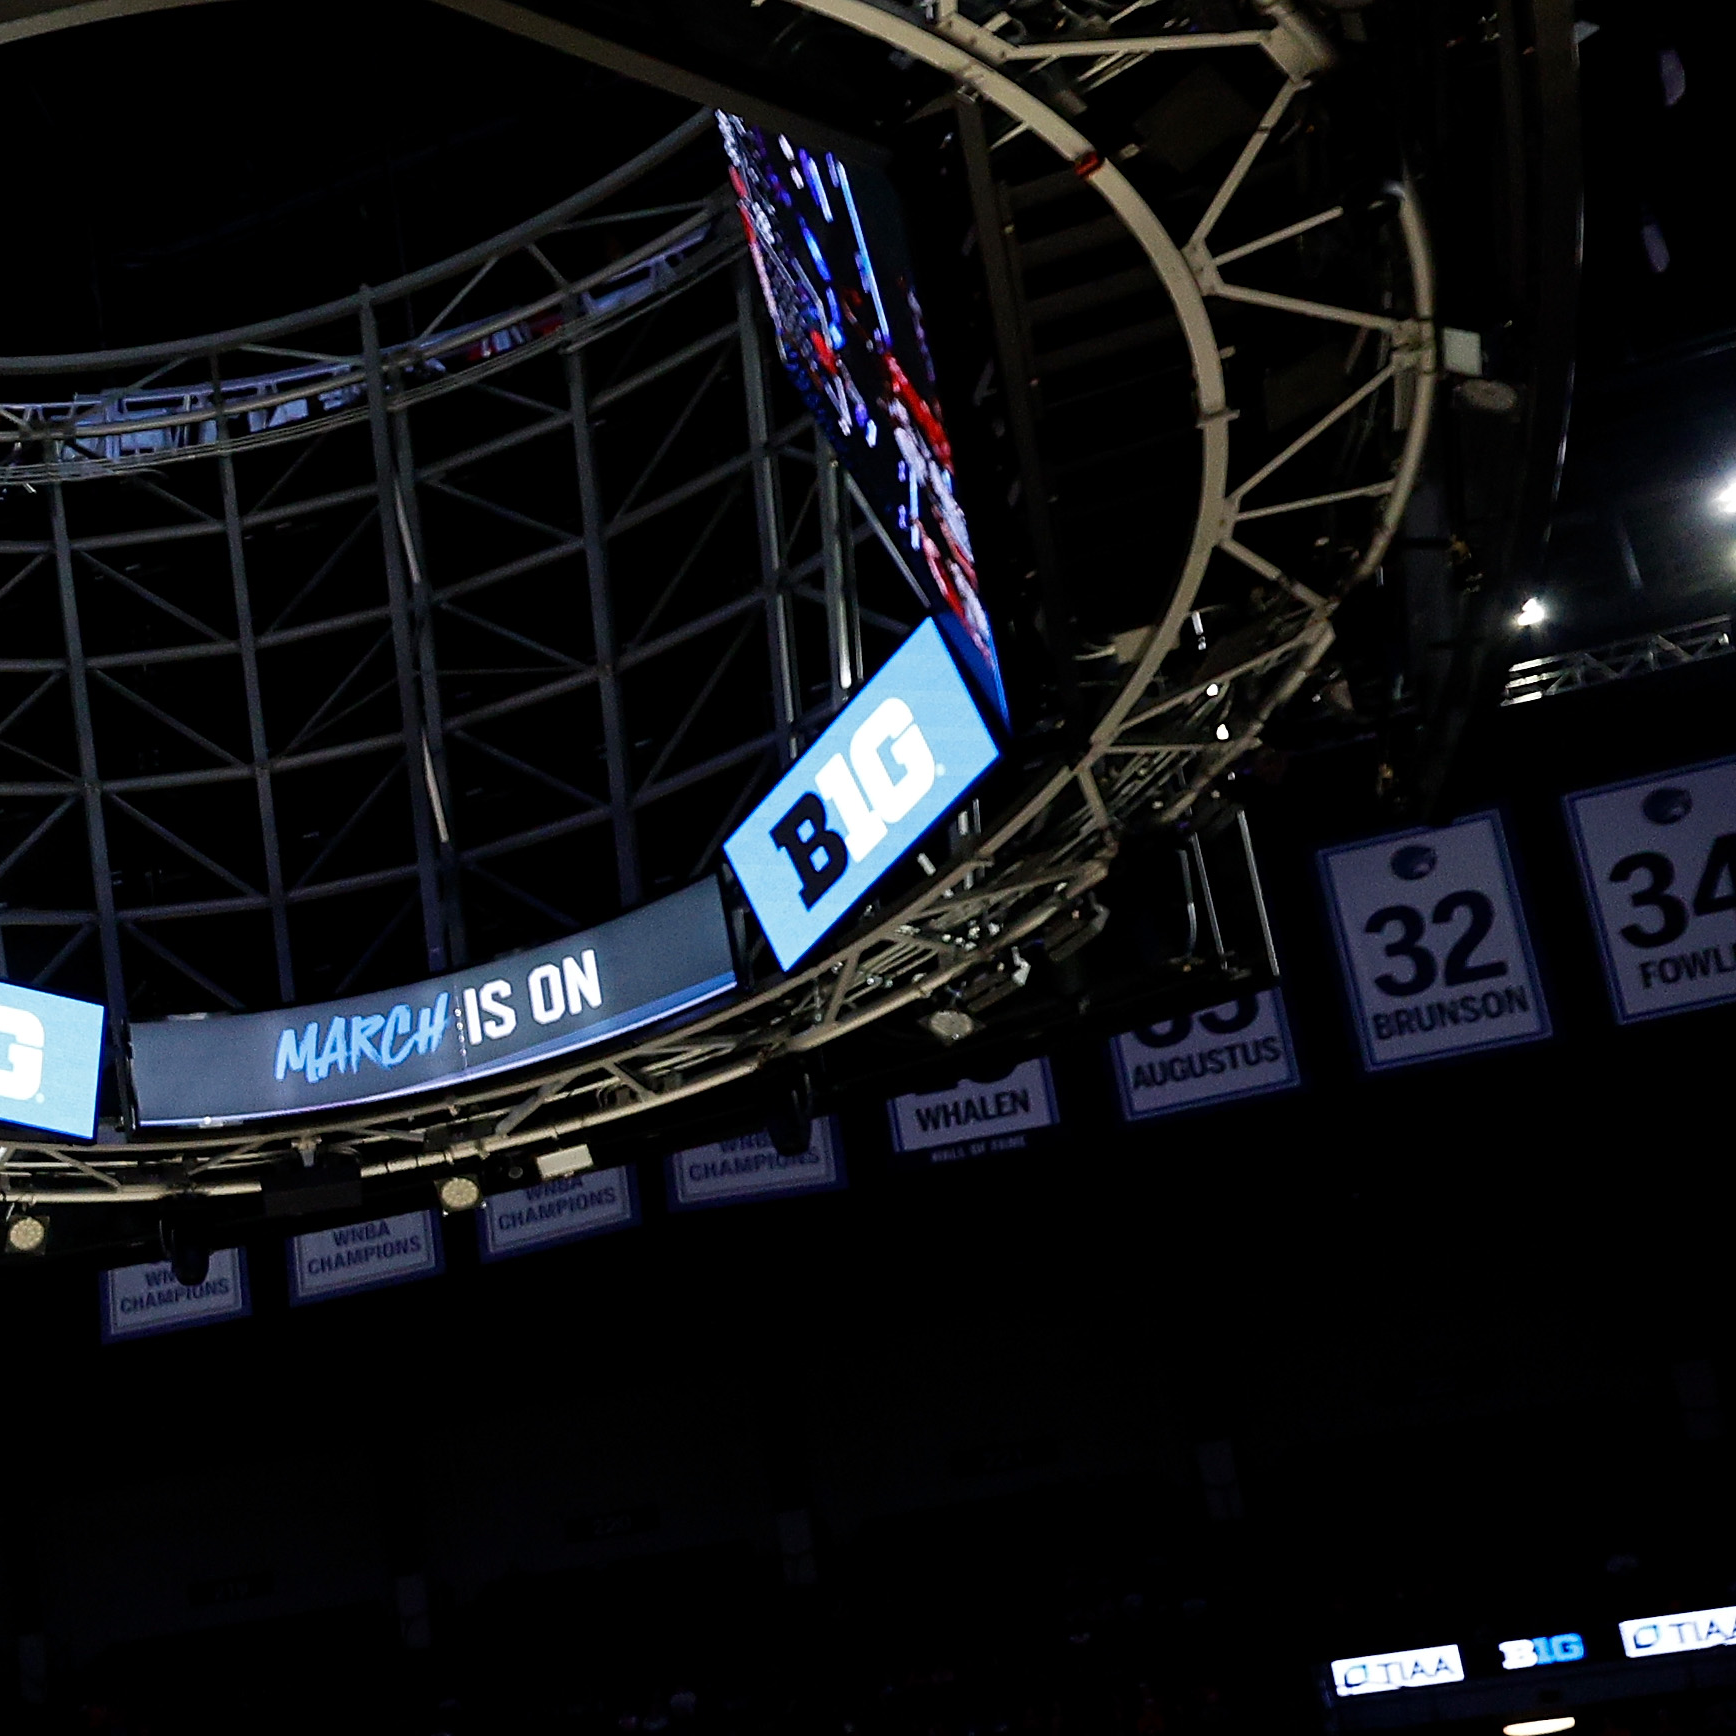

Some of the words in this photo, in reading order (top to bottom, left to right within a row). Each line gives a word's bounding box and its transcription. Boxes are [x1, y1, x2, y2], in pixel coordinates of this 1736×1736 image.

[1364, 888, 1509, 998] 32
[274, 991, 449, 1084] MARCH
[465, 979, 515, 1047] IS
[529, 948, 603, 1023] ON
[1372, 984, 1528, 1042] BRUNSON
[1134, 1037, 1283, 1092] AUGUSTUS
[916, 1088, 1030, 1130] WHALEN
[497, 1186, 618, 1232] CHAMPIONS
[307, 1235, 423, 1276] CHAMPIONS
[332, 1221, 392, 1248] WNBA
[1377, 1656, 1455, 1684] TIAA
